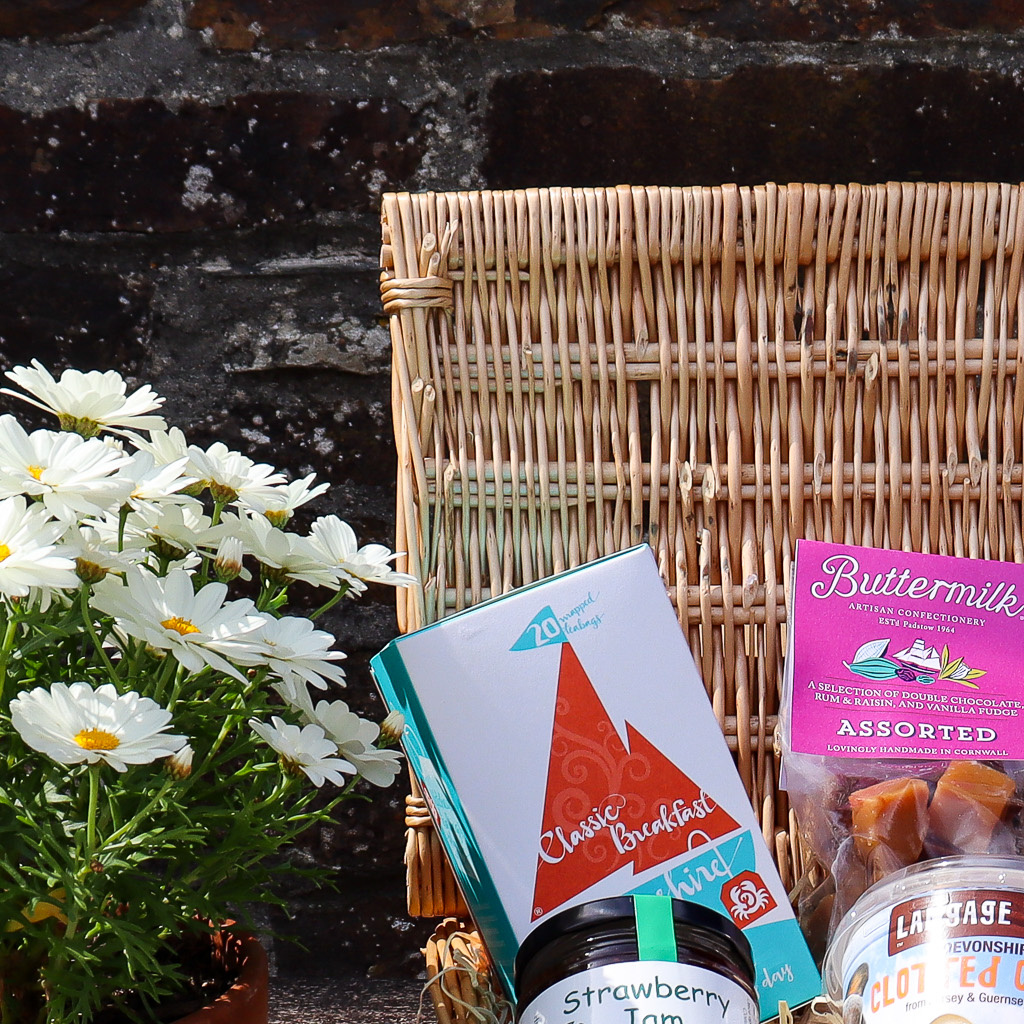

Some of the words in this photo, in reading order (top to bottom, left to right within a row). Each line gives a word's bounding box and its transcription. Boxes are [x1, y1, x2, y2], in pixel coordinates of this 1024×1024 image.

[810, 554, 1024, 618] Buttermilk
[848, 602, 894, 615] ARTISAN
[897, 608, 986, 627] CONFECTIONERY
[903, 620, 934, 632] Padstow
[937, 625, 956, 634] 1964
[526, 616, 561, 647] 20
[807, 680, 816, 690] A
[818, 682, 882, 698] SELECTION
[884, 690, 900, 699] OF
[901, 691, 948, 704] DOUBLE
[950, 696, 1024, 710] CHOCOLATE,
[814, 692, 840, 704] RUM
[842, 695, 853, 705] &
[854, 696, 896, 709] RAISIN,
[898, 700, 924, 711] AND
[926, 702, 976, 715] VANILLA
[978, 706, 1019, 717] FUDGE
[836, 719, 998, 743] ASSORTED
[827, 744, 877, 754] LOVINGLY
[879, 745, 938, 755] HANDMADE
[940, 747, 951, 755] IN
[954, 748, 1009, 756] CORNWALL
[538, 794, 627, 868] Classic
[609, 791, 719, 855] Breakfast
[762, 963, 794, 988] day
[563, 975, 730, 1019] Strawberry
[905, 998, 927, 1013] from
[967, 992, 976, 1003] &
